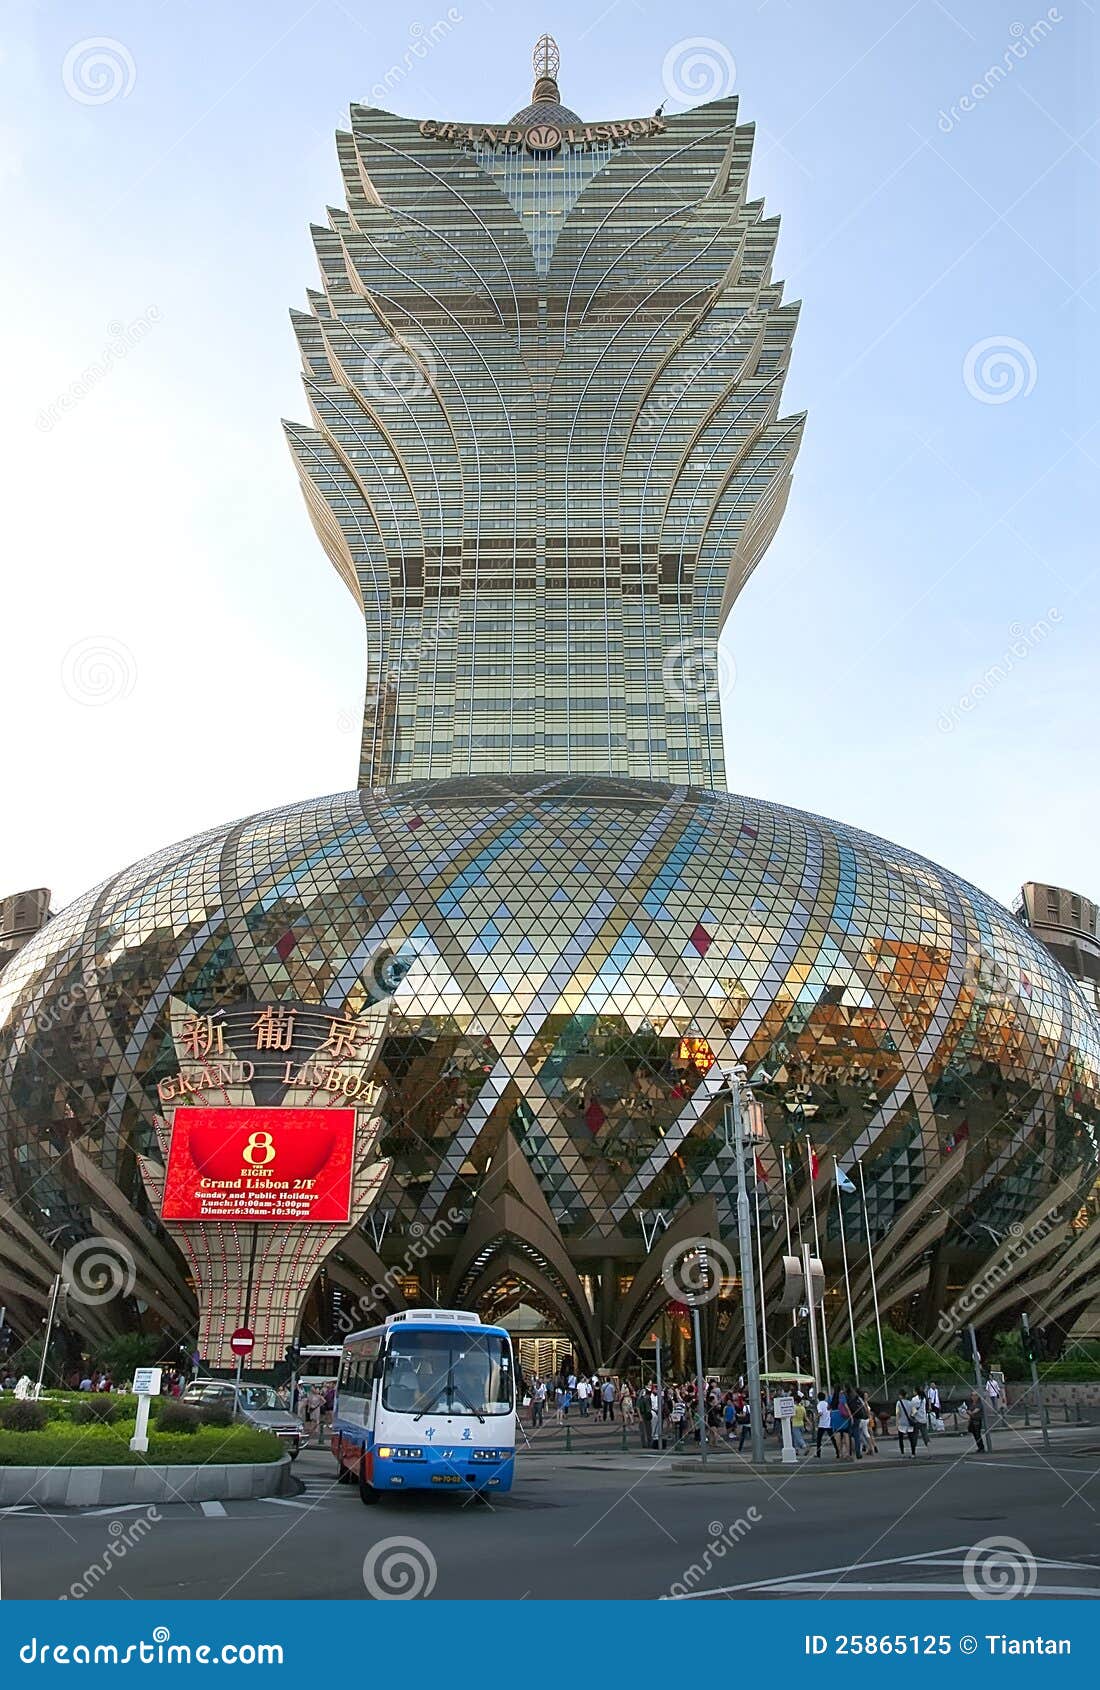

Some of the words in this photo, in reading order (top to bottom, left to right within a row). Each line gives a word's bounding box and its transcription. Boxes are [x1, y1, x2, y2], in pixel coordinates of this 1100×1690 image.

[419, 120, 523, 145] GRAND
[566, 117, 666, 144] LISBOA
[182, 1005, 368, 1058] 新葡京
[157, 1060, 254, 1100] GRAND
[282, 1060, 383, 1104] LISBOA
[242, 1131, 276, 1165] 8
[200, 1178, 242, 1189] Grand
[246, 1178, 289, 1190] Lisboa
[293, 1179, 316, 1190] 2/F
[240, 1169, 274, 1177] EIGHT
[194, 1191, 227, 1199] Sunday
[248, 1192, 277, 1200] Public
[279, 1192, 319, 1200] Holidays
